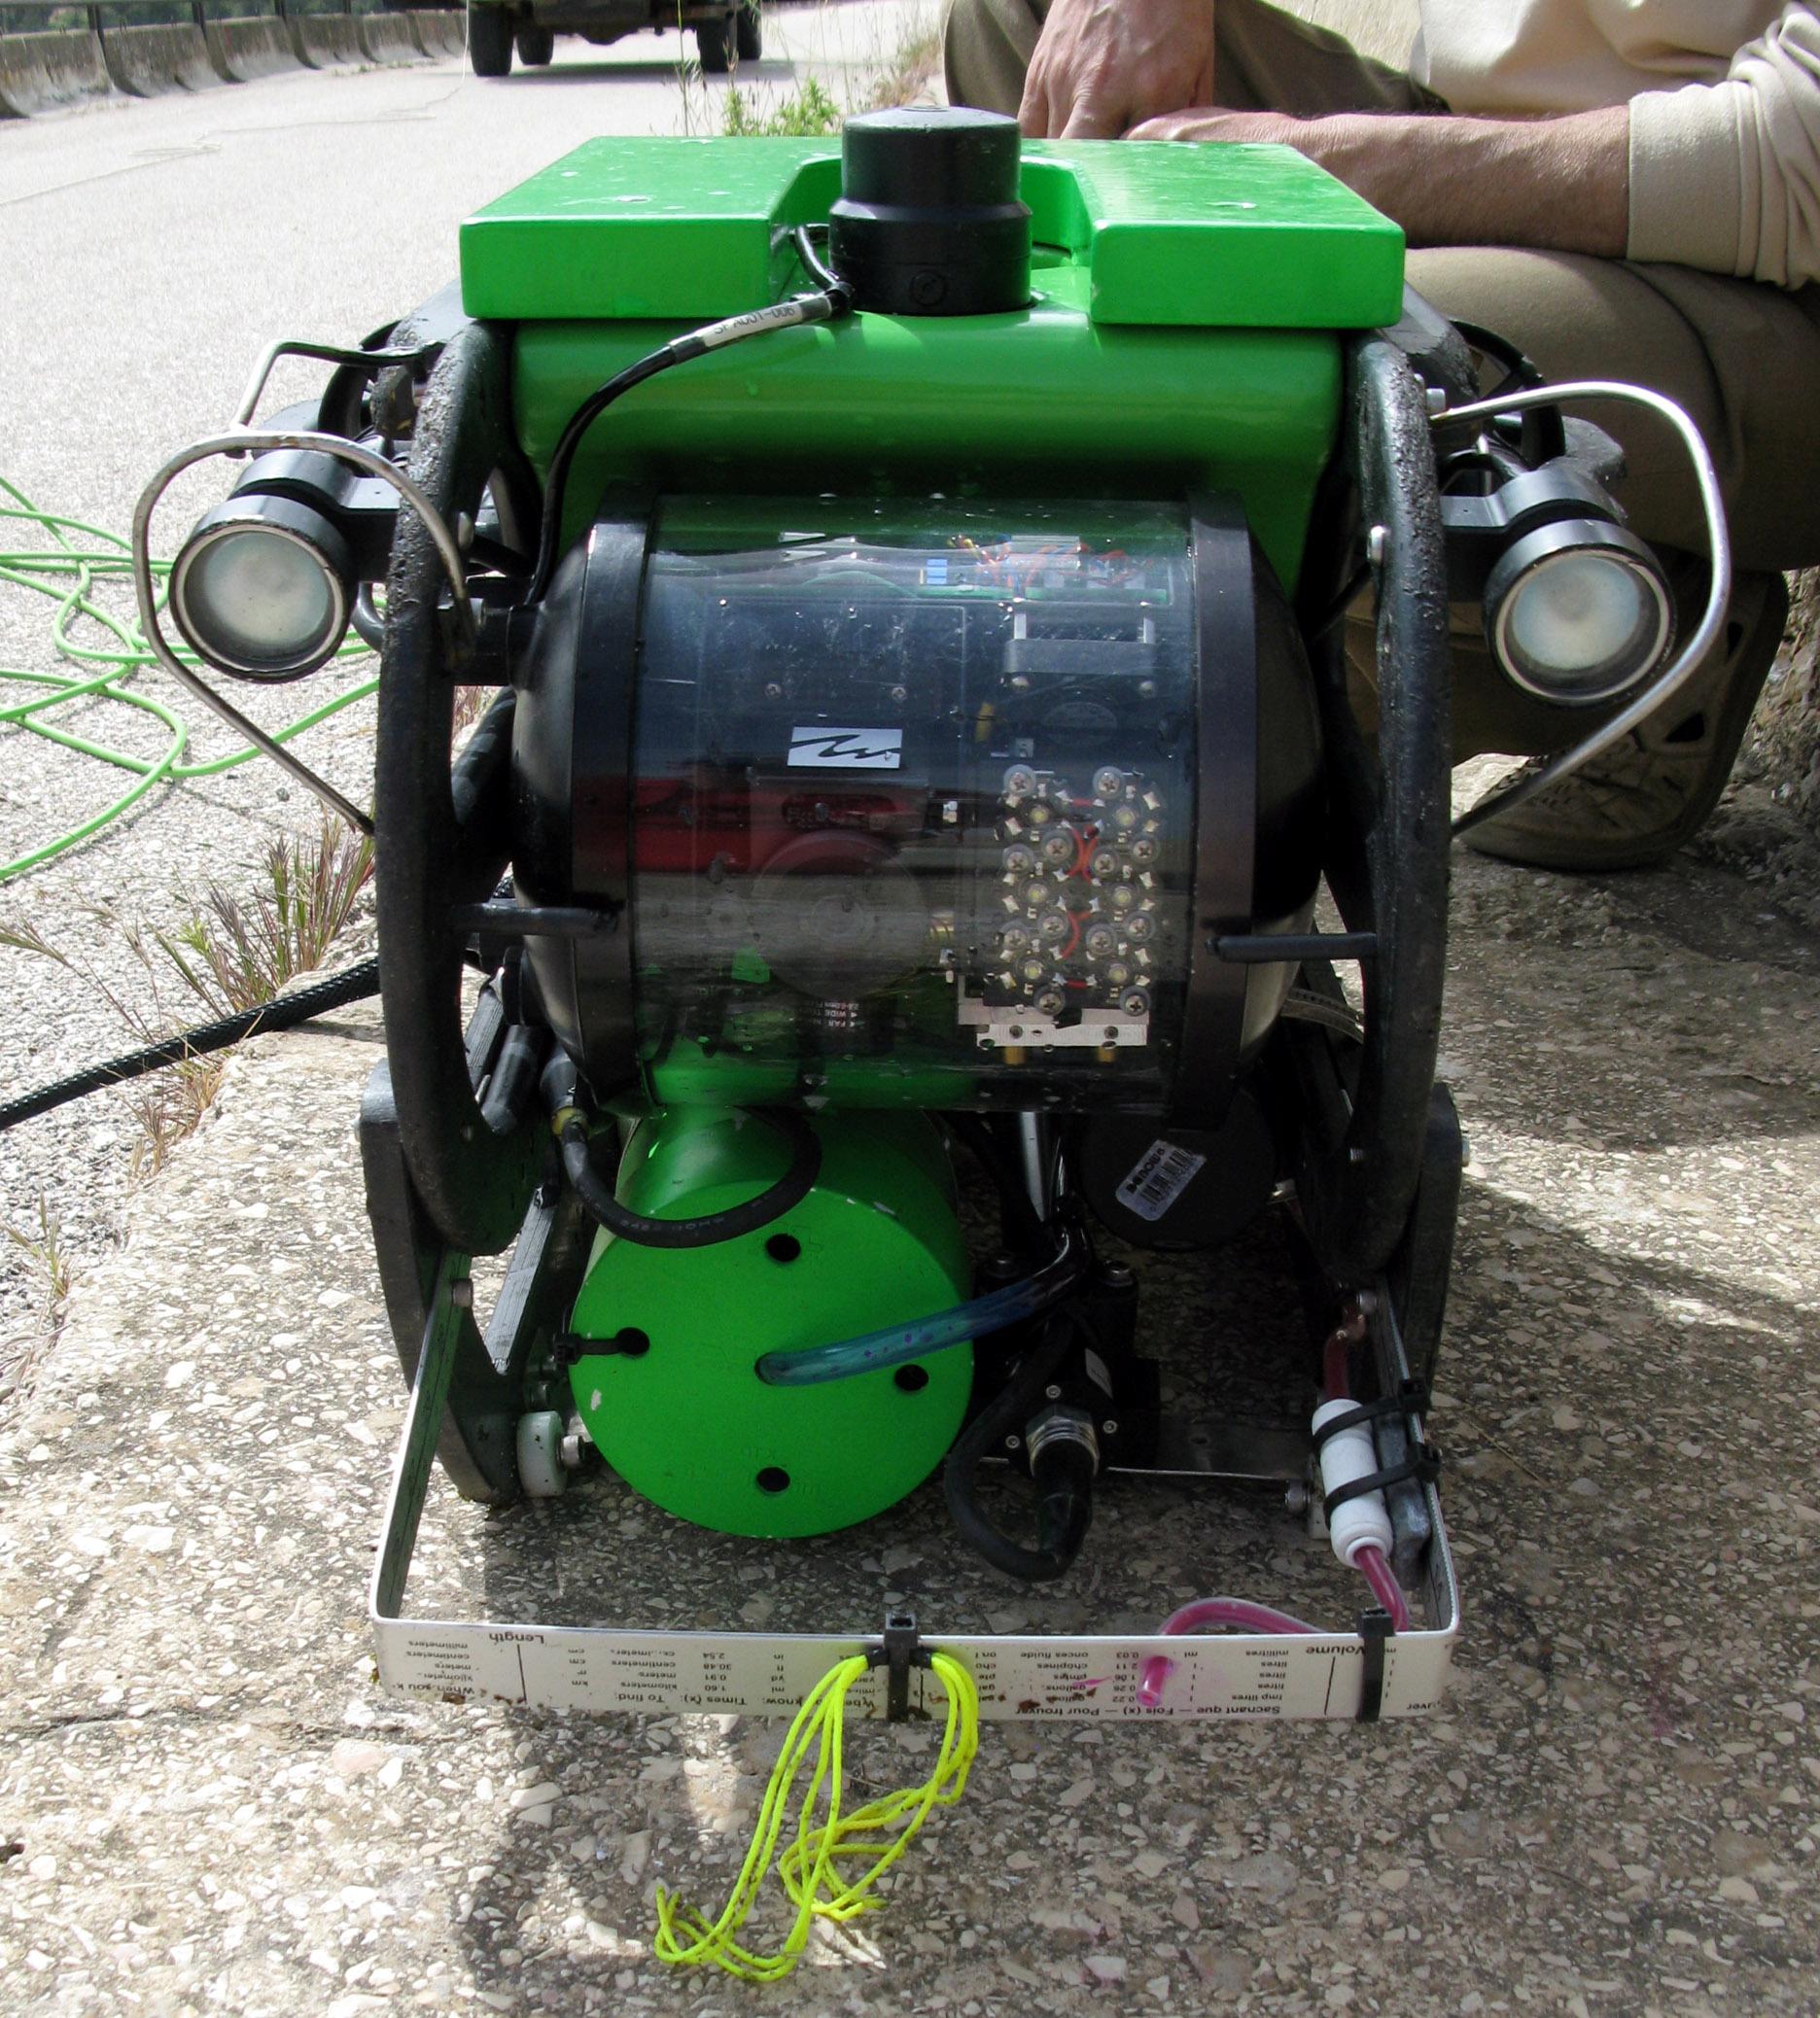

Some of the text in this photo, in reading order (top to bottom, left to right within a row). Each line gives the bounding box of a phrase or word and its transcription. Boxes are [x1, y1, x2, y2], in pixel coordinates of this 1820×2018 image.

[489, 1632, 544, 1645] Length
[1306, 1646, 1365, 1655] Volume
[620, 1682, 678, 1690] kilometers
[648, 1694, 665, 1703] To
[706, 1696, 747, 1706] Times
[1145, 1707, 1173, 1716] Fois
[1196, 1706, 1222, 1715] que
